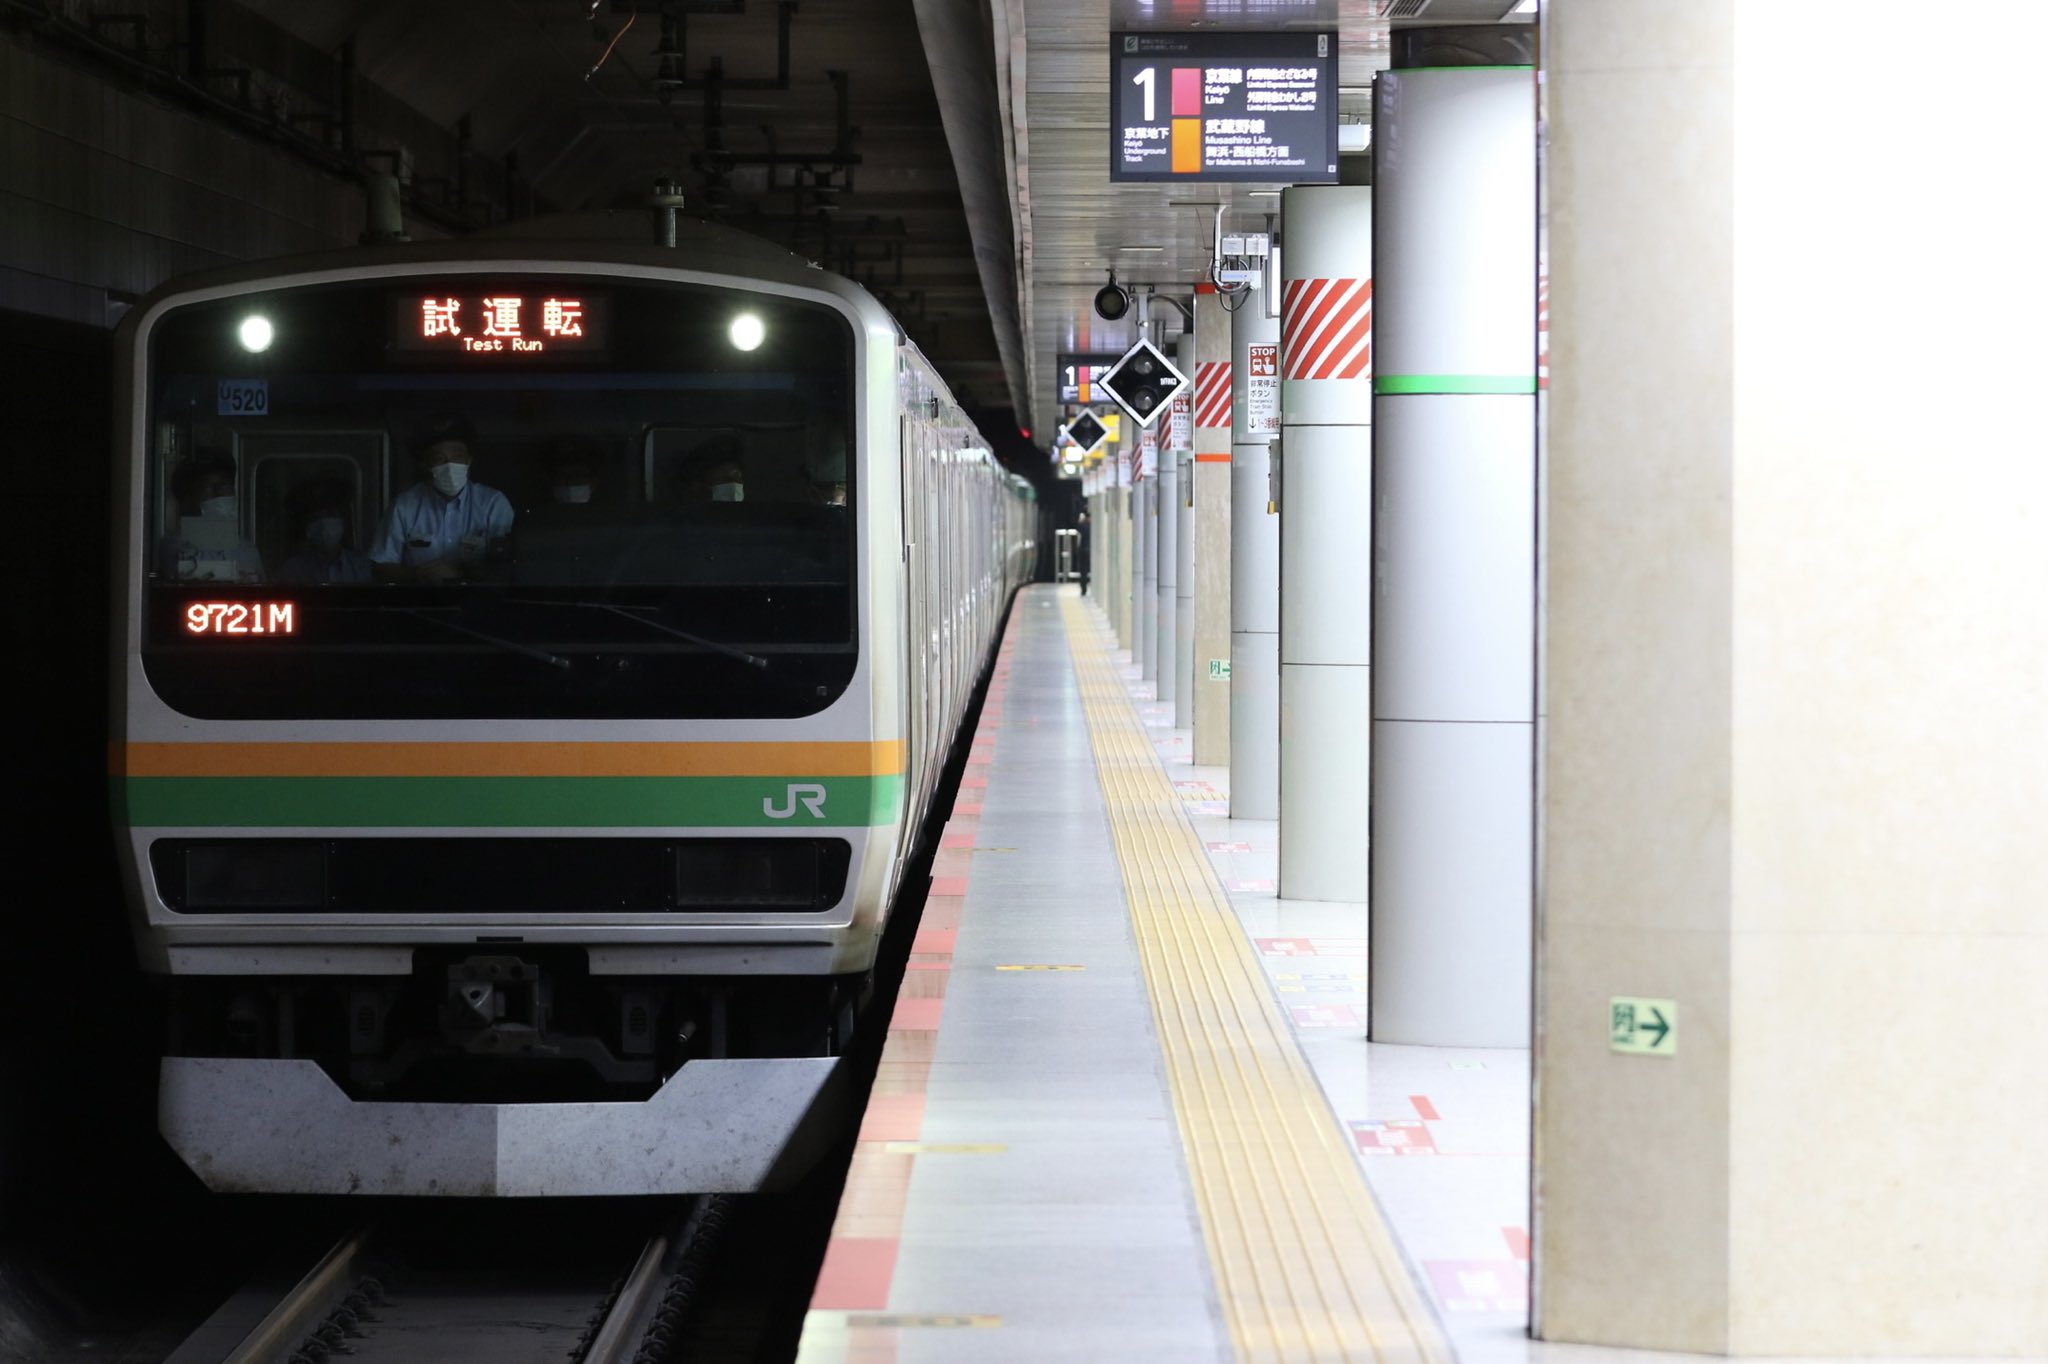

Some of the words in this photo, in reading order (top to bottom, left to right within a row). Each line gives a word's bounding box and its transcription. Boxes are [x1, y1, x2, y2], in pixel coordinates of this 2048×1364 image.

[1133, 67, 1155, 121] 1
[1205, 95, 1224, 104] Line
[1124, 127, 1170, 140] 京葉地下
[1205, 119, 1265, 134] 武蔵野線
[1205, 136, 1252, 144] Musashino
[1254, 136, 1272, 144] Line
[1124, 148, 1167, 156] Underground
[422, 297, 582, 336] 試運転
[464, 337, 503, 351] Test
[512, 337, 543, 351] Run
[1251, 347, 1276, 356] STOP
[1065, 366, 1075, 386] 1
[1250, 390, 1271, 398] ボタン
[187, 603, 293, 633] 9721M
[763, 783, 827, 819] JR
